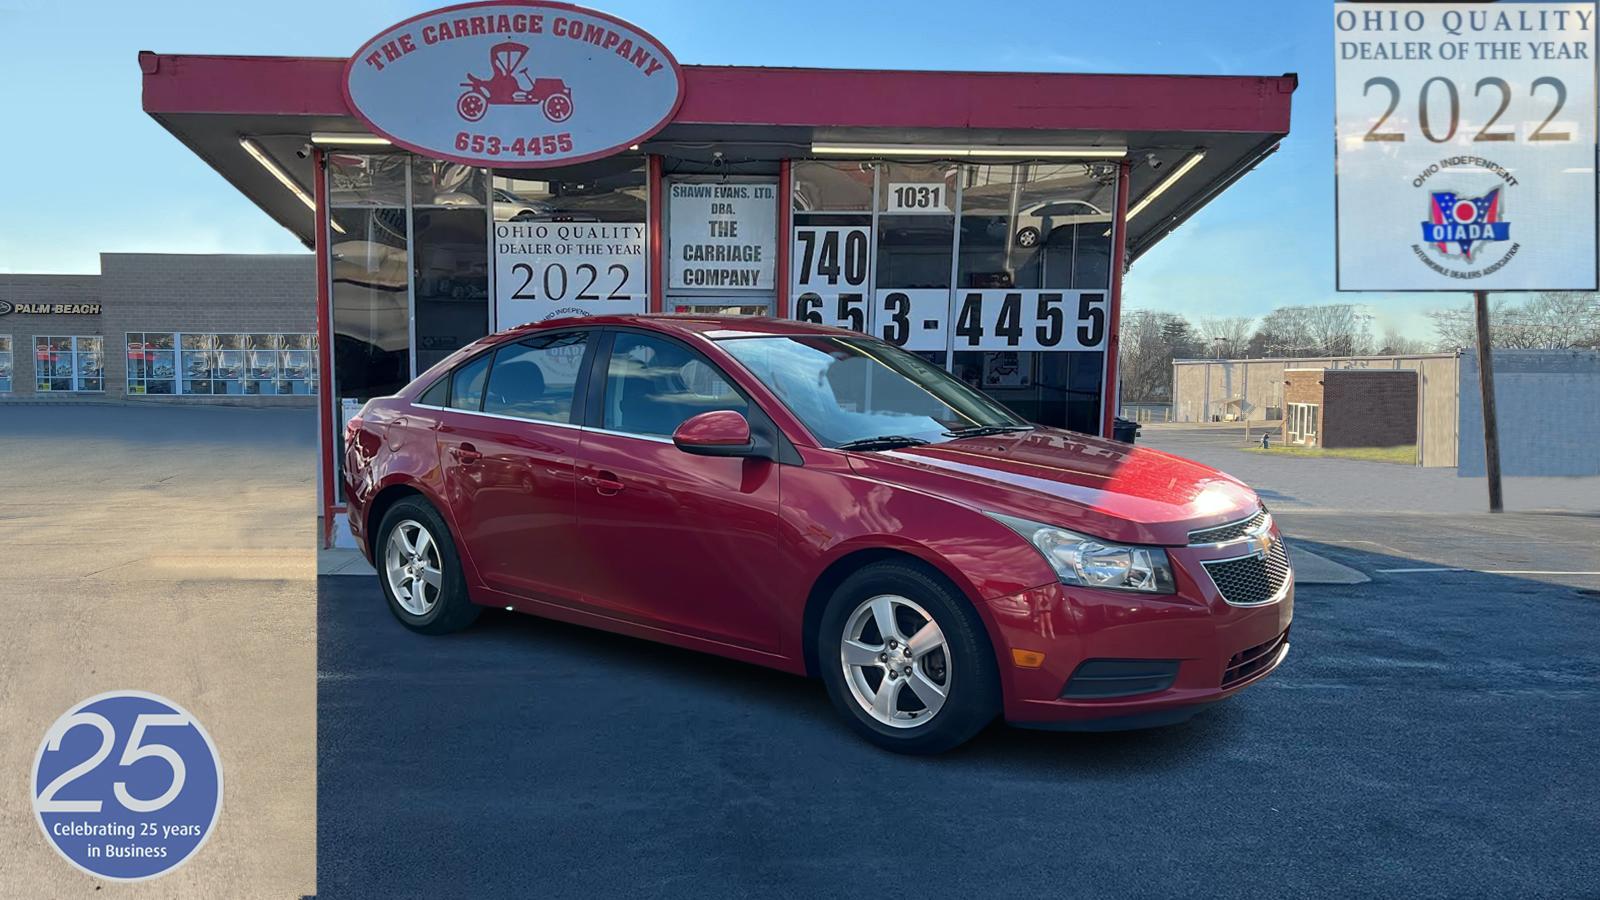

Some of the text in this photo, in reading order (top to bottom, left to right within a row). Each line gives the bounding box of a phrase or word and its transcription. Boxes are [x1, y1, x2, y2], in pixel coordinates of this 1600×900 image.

[1336, 10, 1593, 36] OHIO QUALITY
[365, 14, 665, 77] THE CARRIAGE COMPANY
[1340, 42, 1589, 60] DEALER OF THE YEAR
[1362, 76, 1571, 144] 2022
[454, 131, 574, 157] 653-4455
[1412, 155, 1520, 188] OHIO INDEPENDENT
[672, 186, 712, 198] SHAWN
[754, 187, 775, 199] LTD.
[894, 186, 941, 209] 1031
[711, 203, 736, 215] DBA.
[496, 226, 644, 241] OHIO QUALITY
[709, 221, 738, 238] THE
[1432, 224, 1496, 241] OIADA
[499, 244, 642, 255] DEALER OF THE YEAR
[683, 245, 762, 262] CARRIAGE
[797, 231, 868, 286] 740
[1411, 242, 1521, 279] AUTOMOBILE DEALERS ASSOCIATION
[511, 263, 632, 301] 2022
[683, 268, 760, 286] COMPANY
[15, 304, 100, 314] PALM BEACH
[555, 307, 593, 318] INDEPEND
